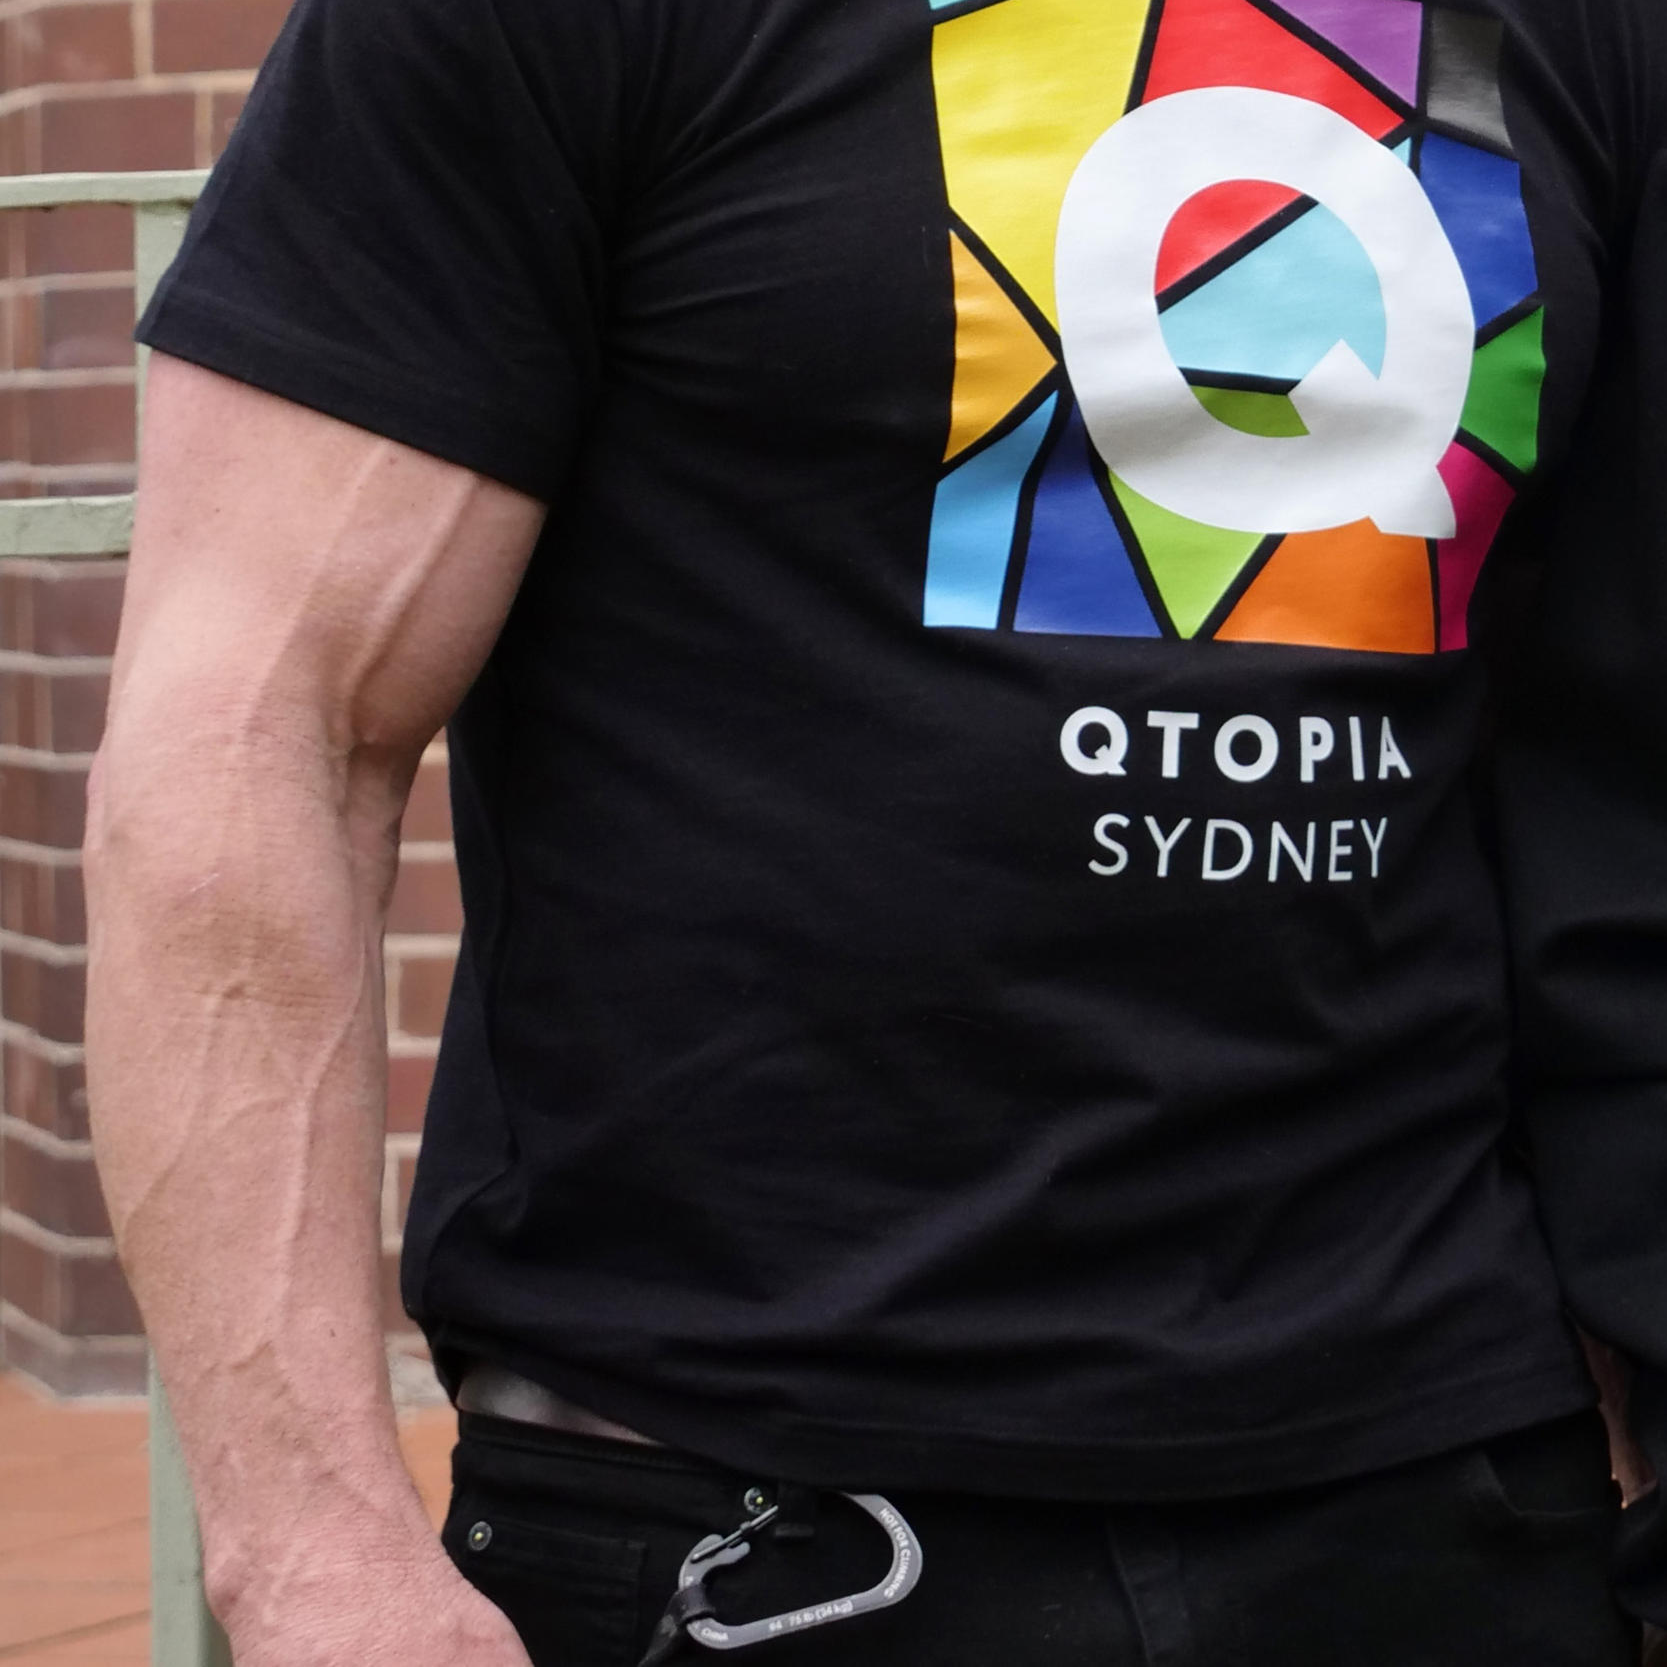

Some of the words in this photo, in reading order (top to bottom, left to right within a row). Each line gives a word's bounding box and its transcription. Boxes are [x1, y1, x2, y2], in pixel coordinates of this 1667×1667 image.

[1060, 705, 1412, 783] QTOPIA
[1088, 813, 1387, 882] SYDNEY
[880, 1507, 899, 1529] NOT
[893, 1527, 910, 1547] FOR
[884, 1549, 911, 1599] CLIMBING
